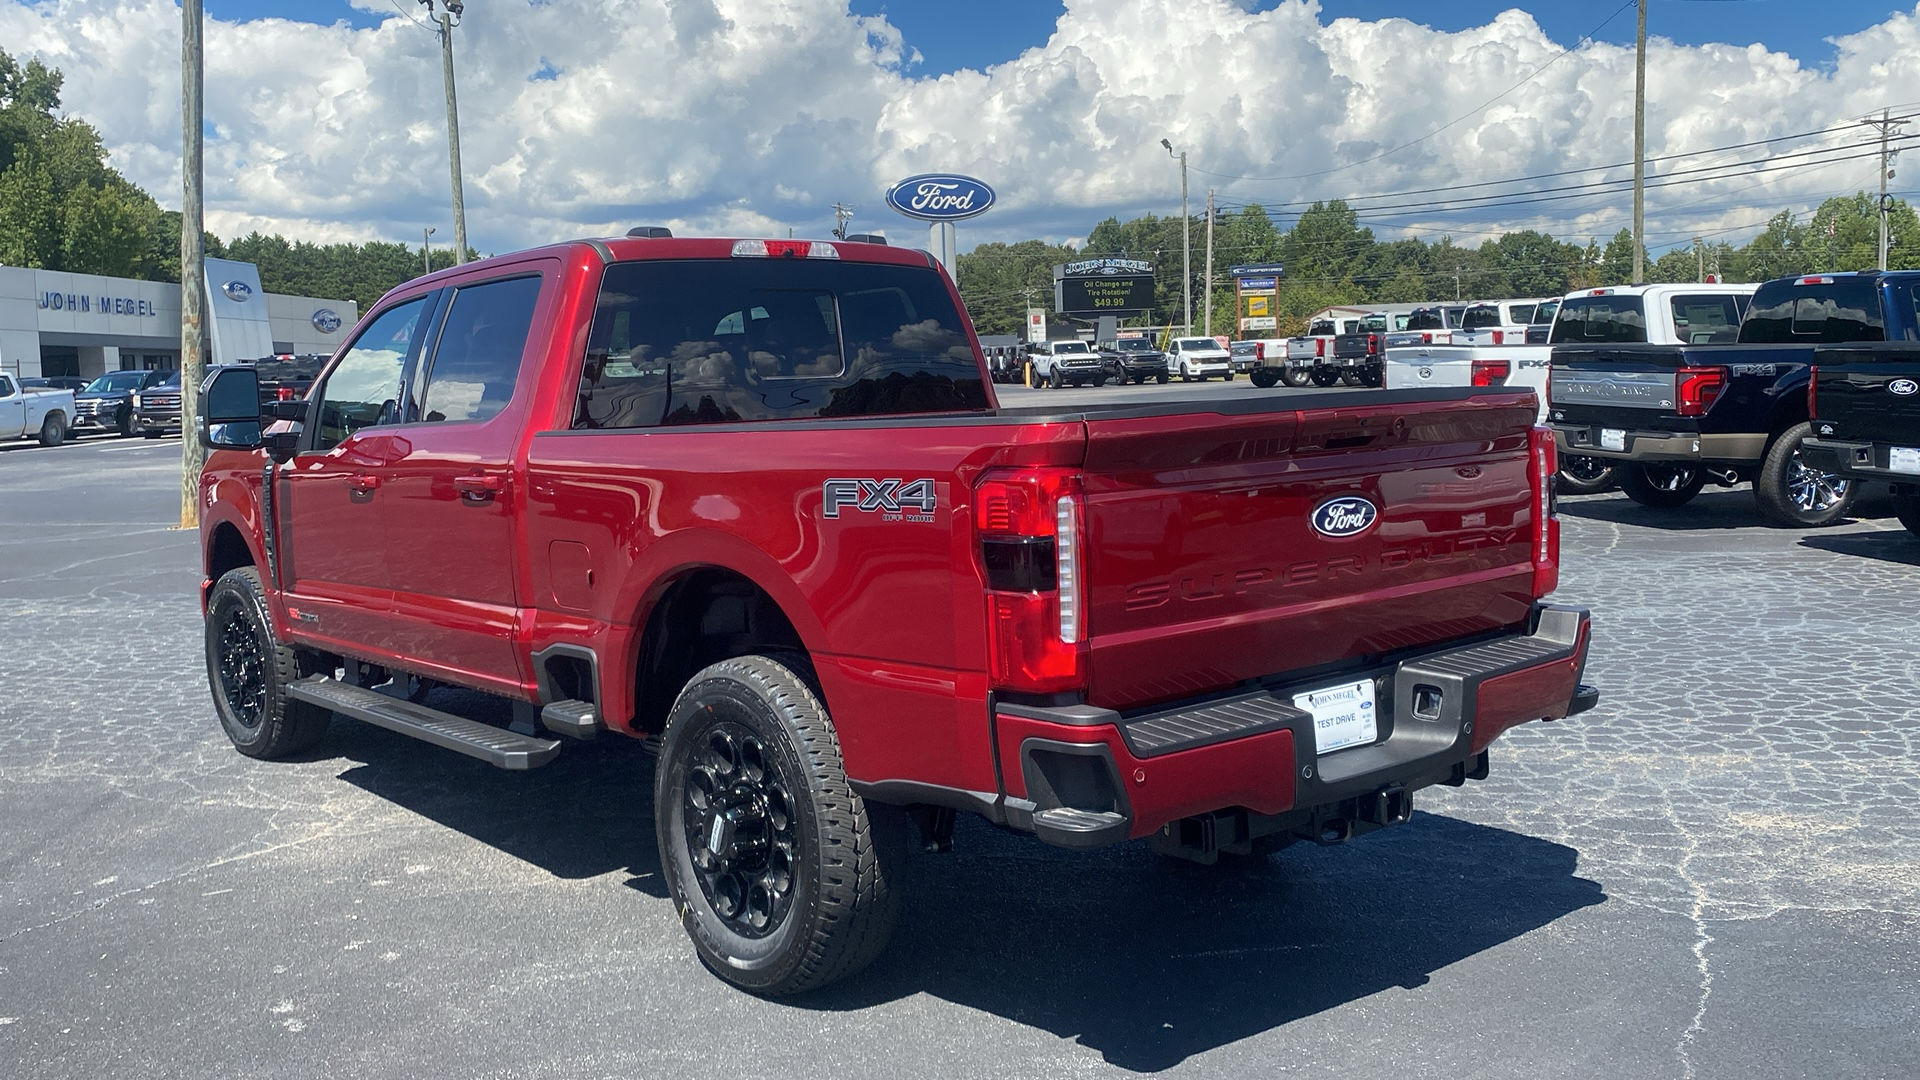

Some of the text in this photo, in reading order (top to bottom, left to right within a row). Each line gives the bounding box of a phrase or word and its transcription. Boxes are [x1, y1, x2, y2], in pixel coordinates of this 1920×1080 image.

[911, 183, 975, 210] Ford
[1065, 258, 1153, 274] JOHN MEGEL
[41, 291, 156, 316] JOHN MEGEL
[1094, 298, 1125, 308] $49.99
[1732, 364, 1776, 377] FX4
[1893, 381, 1913, 392] Ford
[823, 478, 937, 519] FX4
[882, 513, 935, 522] OFF ROAD
[1324, 502, 1366, 531] Ford
[1126, 529, 1517, 612] SUPER DUTY
[1333, 689, 1356, 700] MEGEL
[1317, 717, 1335, 729] TEST
[1335, 713, 1356, 725] DRIVE
